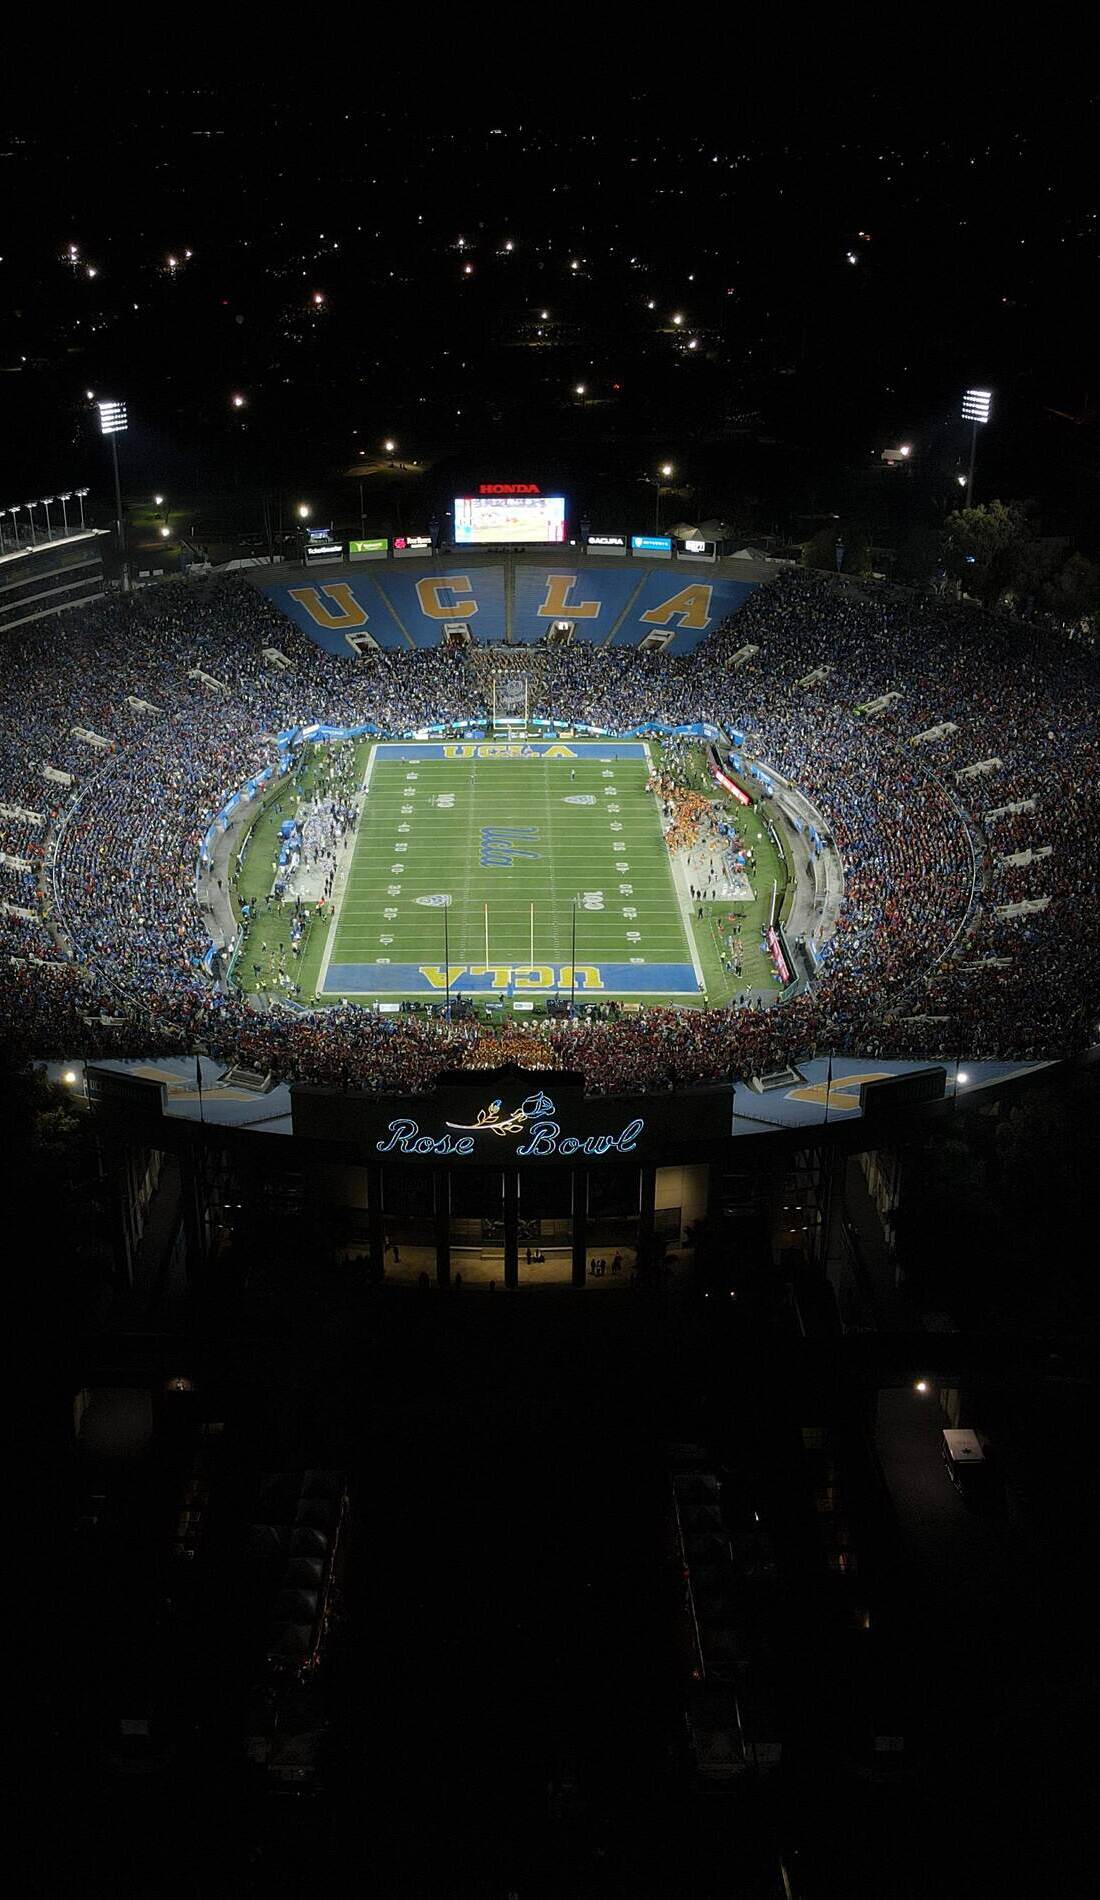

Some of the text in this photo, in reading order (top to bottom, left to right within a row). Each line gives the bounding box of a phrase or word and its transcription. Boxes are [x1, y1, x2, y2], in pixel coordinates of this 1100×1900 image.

[480, 484, 540, 494] HONDA
[443, 745, 578, 759] UCLA
[438, 794, 455, 807] 100
[616, 862, 630, 871] 40
[619, 884, 633, 894] 30
[583, 891, 605, 910] 100
[384, 907, 398, 917] 20
[622, 907, 637, 918] 20
[380, 933, 394, 943] 10
[626, 931, 641, 941] 10
[418, 966, 605, 988] UCLA
[376, 1118, 645, 1156] Rose Bowl
